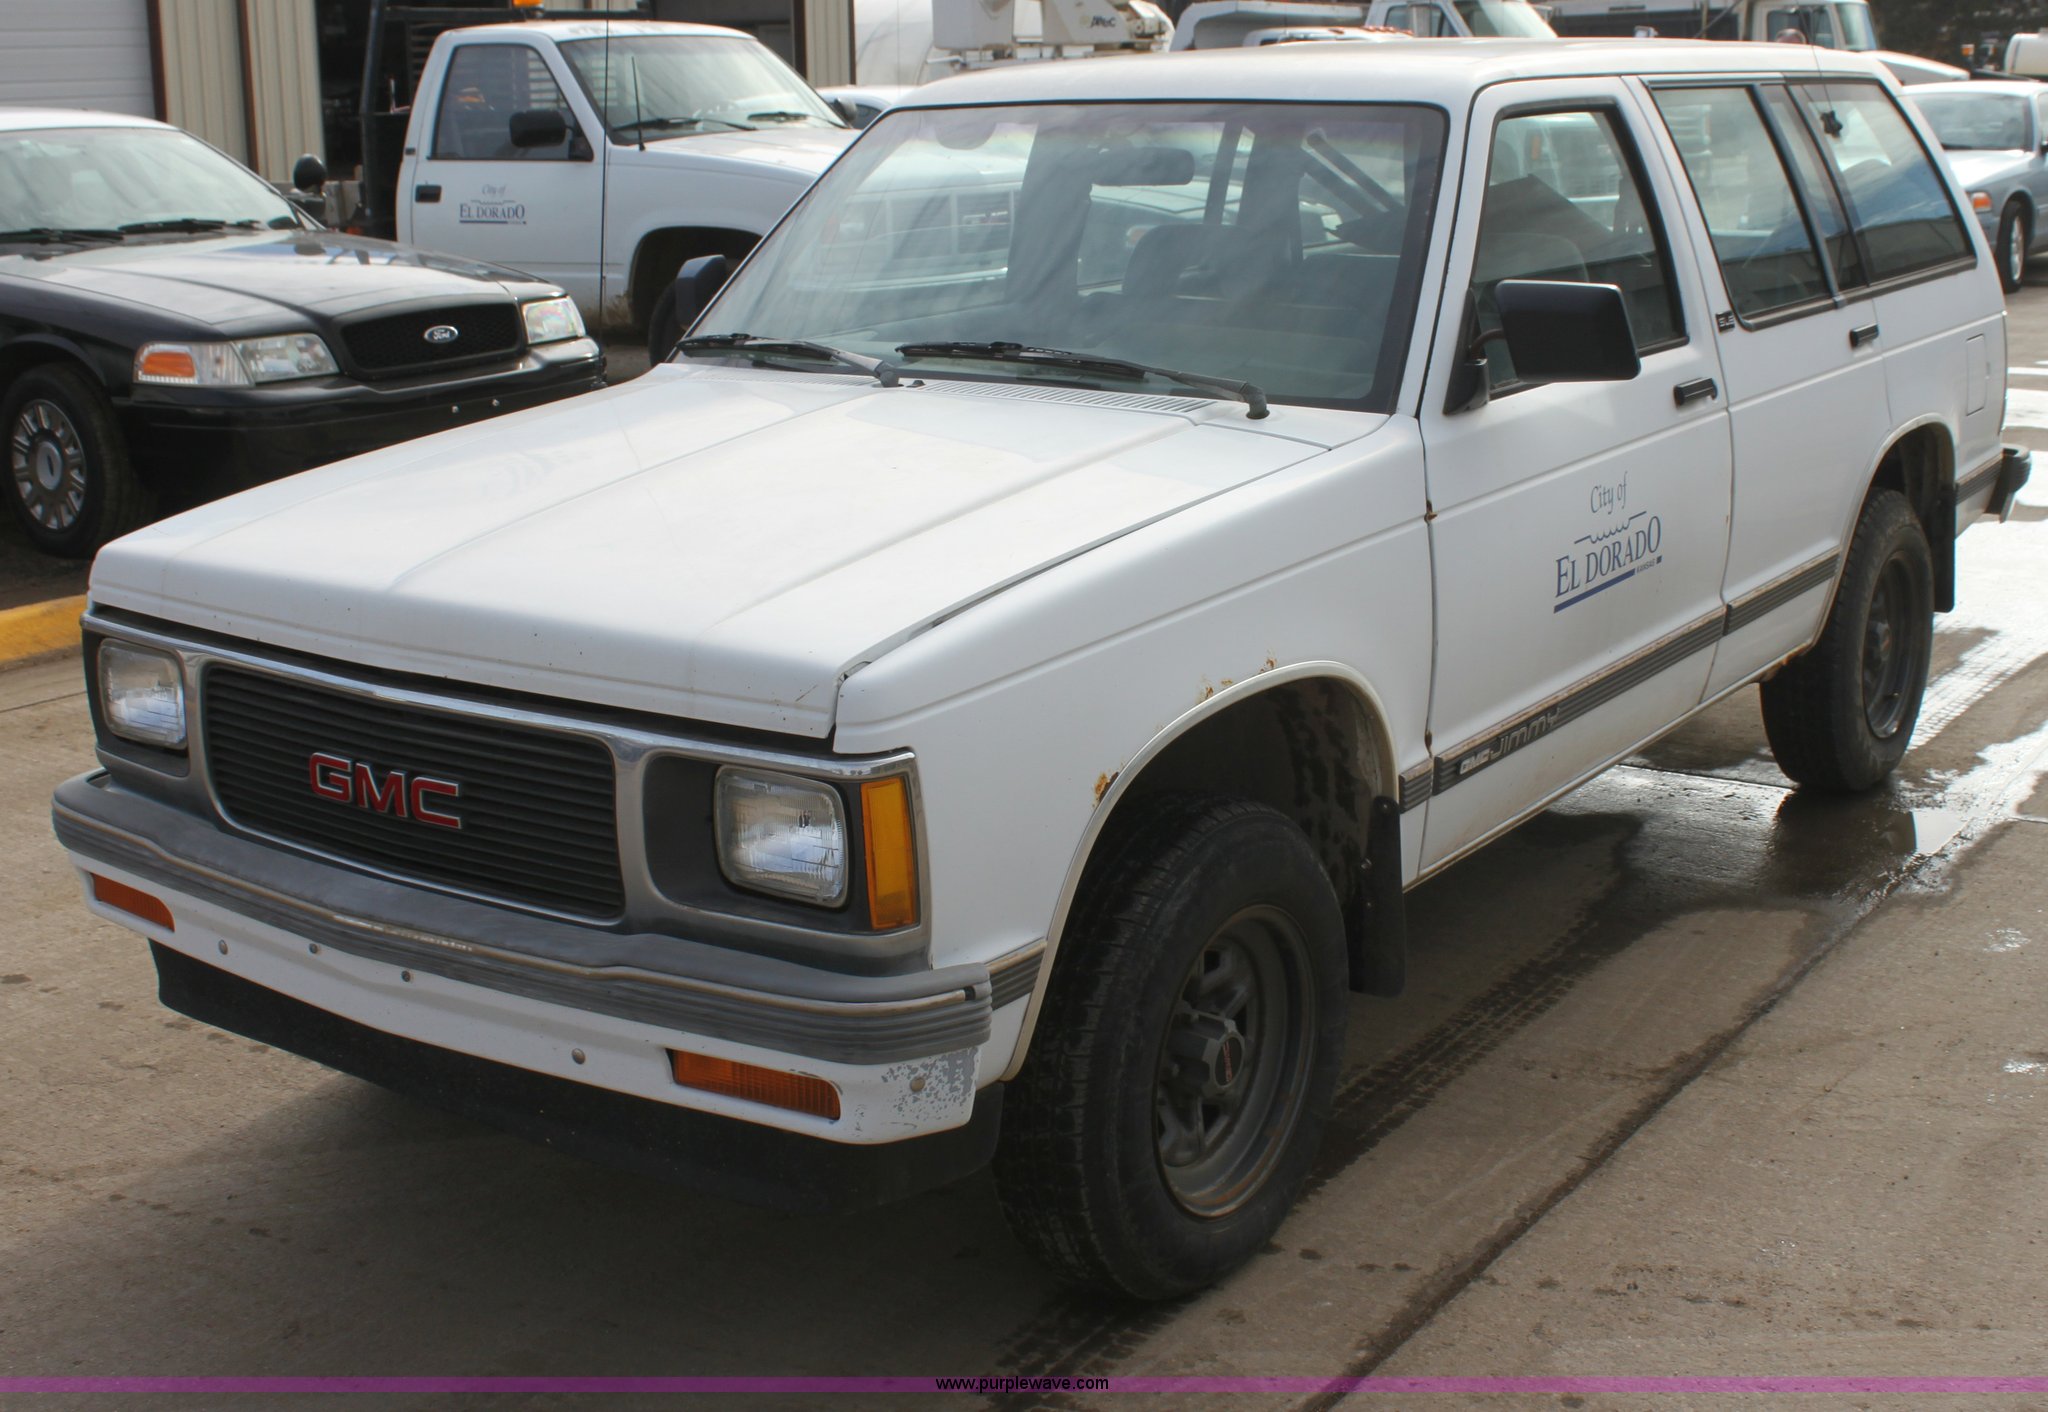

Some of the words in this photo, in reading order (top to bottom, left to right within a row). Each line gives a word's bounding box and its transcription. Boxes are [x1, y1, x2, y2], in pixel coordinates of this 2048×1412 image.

[459, 203, 475, 218] EL
[477, 204, 526, 219] DORADO
[1590, 484, 1614, 515] City
[1617, 471, 1628, 509] of
[1555, 555, 1580, 598] EL
[1585, 515, 1661, 584] DORADO
[309, 752, 463, 830] GMC
